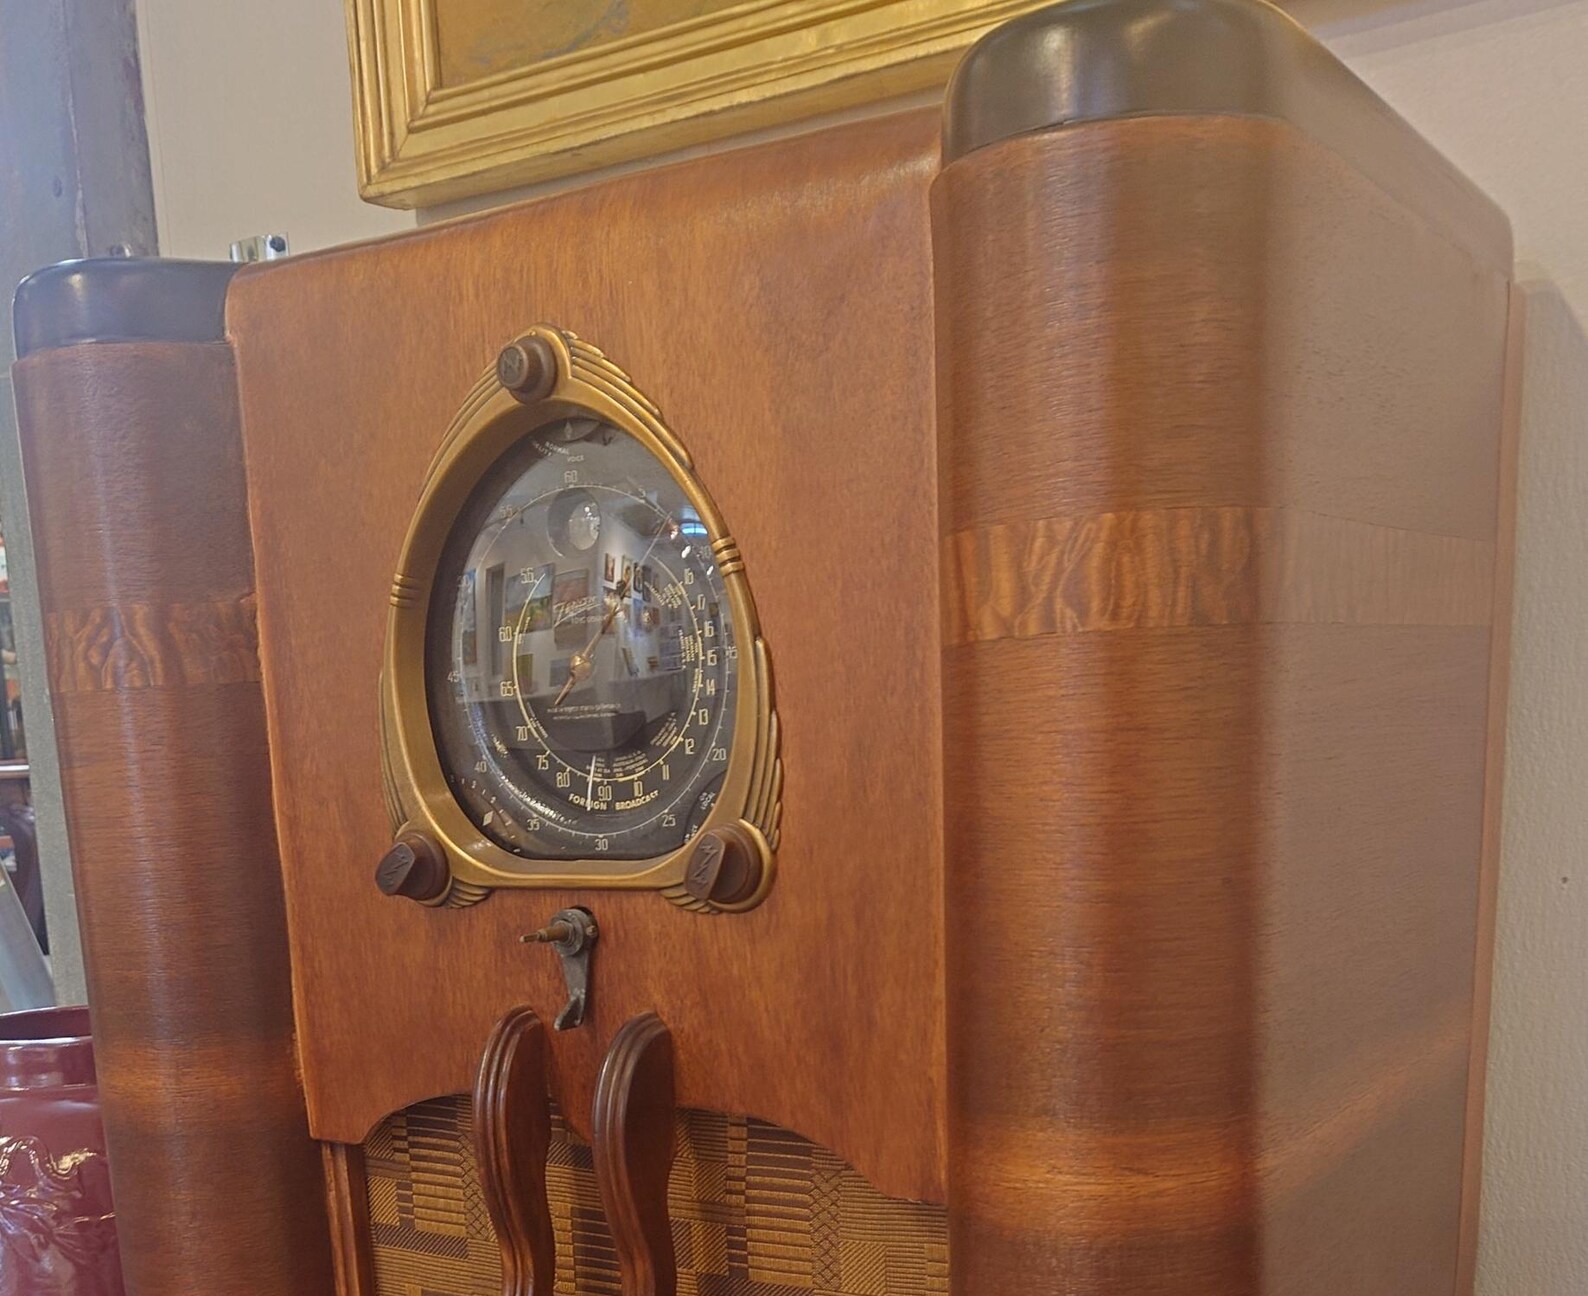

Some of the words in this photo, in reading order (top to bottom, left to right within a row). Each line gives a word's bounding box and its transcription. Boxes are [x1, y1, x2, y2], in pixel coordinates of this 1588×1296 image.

[567, 455, 584, 463] VOICE
[564, 470, 578, 483] 60
[704, 621, 715, 637] 16
[706, 679, 716, 696] 14
[698, 708, 709, 725] 13
[685, 738, 695, 755] 12
[712, 748, 726, 761] 20
[474, 761, 487, 773] 40
[662, 764, 670, 780] 11
[633, 780, 643, 797] 10
[615, 790, 659, 811] BROADCAST
[527, 818, 540, 831] 35
[662, 814, 677, 827] 25
[595, 839, 608, 851] 30
